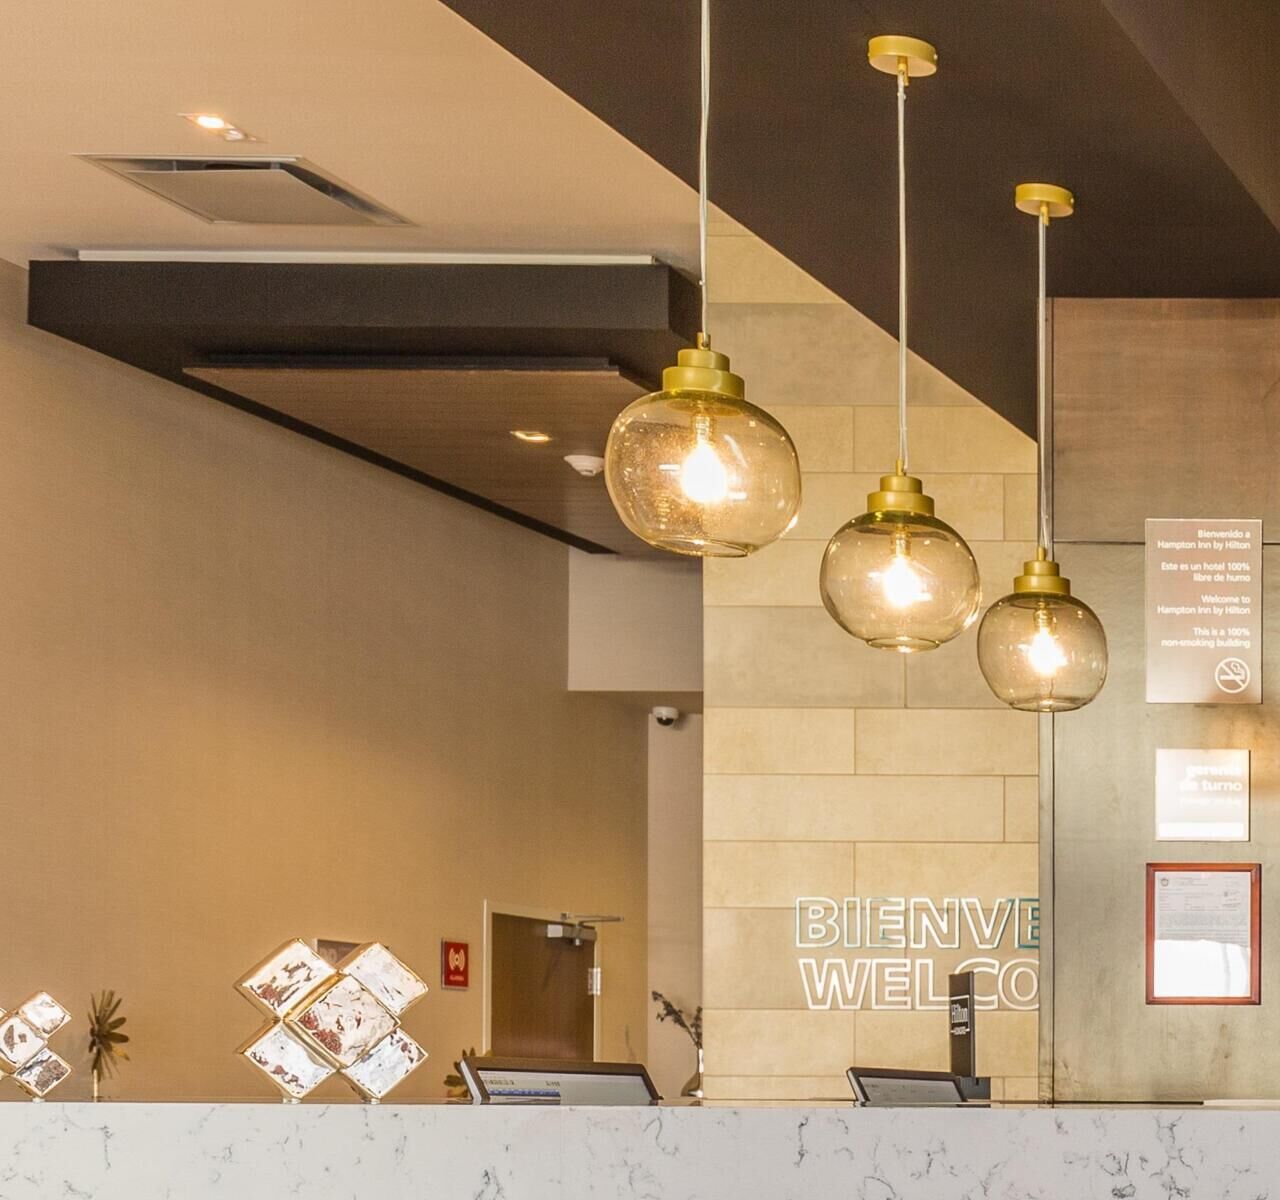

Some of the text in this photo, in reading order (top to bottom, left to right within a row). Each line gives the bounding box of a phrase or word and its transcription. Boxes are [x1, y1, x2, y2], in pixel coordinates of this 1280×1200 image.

[1198, 529, 1243, 538] Bienvenido
[1157, 541, 1251, 551] Hampton Inn by Hilton
[1161, 562, 1178, 571] Este
[1203, 562, 1225, 571] hotel
[1228, 562, 1251, 571] 100%
[1193, 573, 1251, 582] libre de humo
[1201, 595, 1251, 604] Welcome to
[1157, 605, 1251, 616] Hampton Inn by Hilton
[1193, 627, 1210, 636] This
[1211, 627, 1218, 636] is
[1228, 627, 1251, 636] 100%
[1161, 639, 1251, 649] non-smoking building
[1202, 780, 1242, 791] turno
